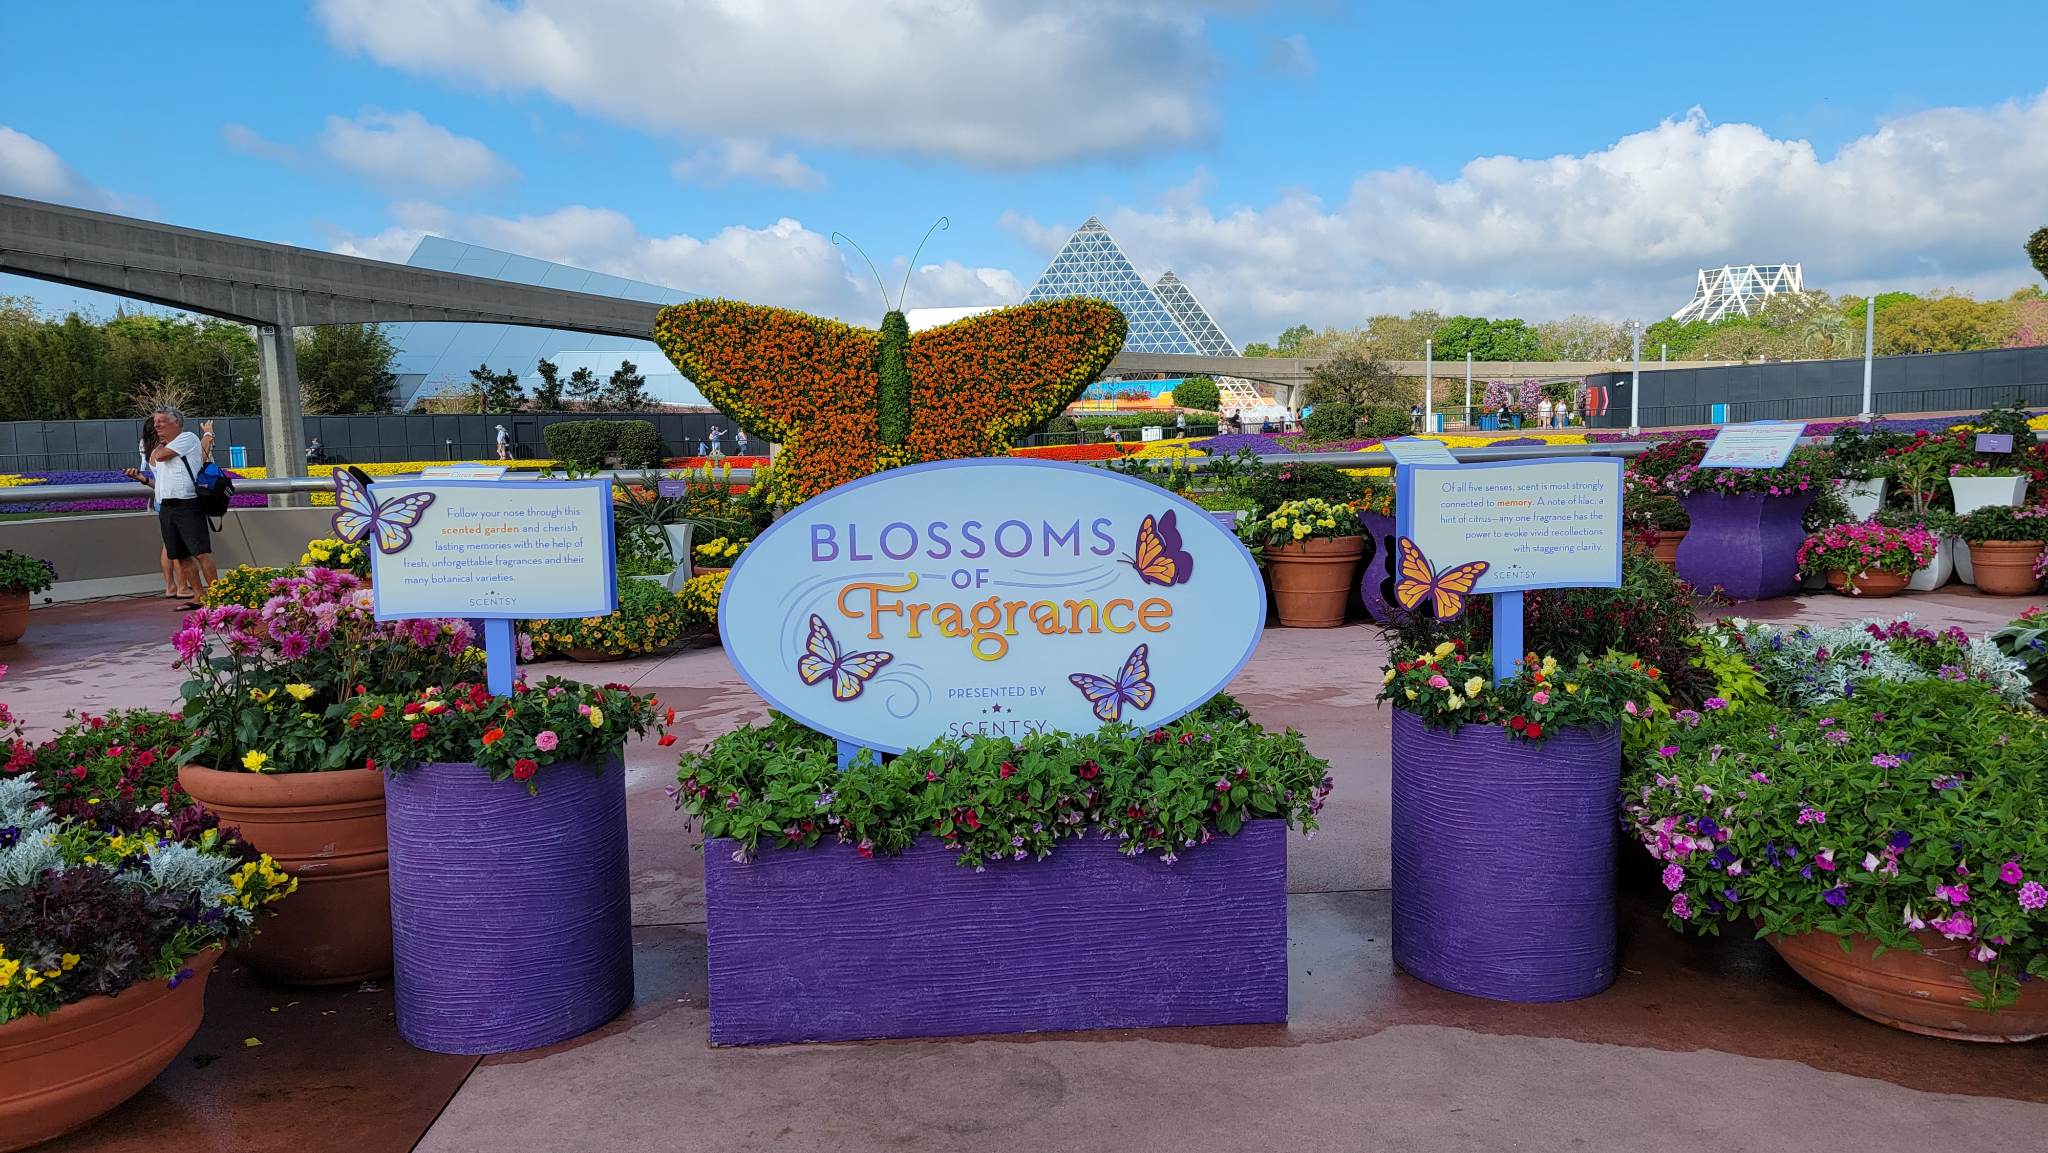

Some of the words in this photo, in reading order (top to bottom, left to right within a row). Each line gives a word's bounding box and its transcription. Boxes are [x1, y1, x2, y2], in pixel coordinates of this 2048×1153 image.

[1441, 482, 1455, 493] Of
[1457, 481, 1467, 492] all
[1468, 482, 1483, 492] five
[1517, 483, 1539, 491] scent
[1541, 482, 1548, 490] is
[1550, 482, 1569, 490] most
[1572, 480, 1604, 491] strongly
[1440, 497, 1484, 508] connected
[1486, 499, 1495, 507] to
[1497, 499, 1535, 509] memory.
[1537, 496, 1545, 506] A
[1547, 498, 1566, 506] note
[1567, 495, 1577, 505] of
[447, 507, 478, 519] Follow
[480, 510, 500, 519] your
[527, 506, 562, 519] through
[564, 505, 581, 516] this
[1440, 513, 1457, 524] hint
[1458, 513, 1467, 523] of
[1533, 511, 1572, 523] fragrance
[1574, 511, 1588, 520] has
[1590, 509, 1604, 520] the
[442, 524, 481, 535] scented
[484, 523, 519, 536] garden
[522, 523, 540, 533] and
[543, 521, 578, 532] cherish
[1465, 532, 1491, 542] power
[1493, 529, 1501, 538] to
[1504, 528, 1528, 537] evoke
[1531, 527, 1549, 537] vivid
[1551, 526, 1604, 537] recollections
[435, 541, 464, 552] lasting
[467, 541, 512, 551] memories
[514, 539, 533, 549] with
[535, 538, 550, 548] the
[552, 537, 572, 550] help
[575, 537, 584, 548] of
[810, 518, 1115, 562] BLOSSOMS
[1513, 542, 1531, 553] with
[1533, 543, 1575, 555] staggering
[1577, 541, 1603, 552] clarity.
[403, 557, 429, 568] fresh,
[432, 555, 493, 569] unforgettable
[495, 554, 542, 568] fragrances
[544, 554, 561, 565] and
[564, 553, 584, 564] their
[404, 576, 428, 586] many
[431, 572, 473, 584] botanical
[476, 573, 516, 582] varieties.
[951, 568, 989, 589] OF
[1493, 571, 1537, 580] SCENTSY
[469, 598, 517, 607] SCENTSY
[837, 571, 1172, 661] Fragrance
[948, 686, 1026, 699] PRESENTED
[1030, 686, 1047, 697] BY
[949, 719, 1048, 738] SCENTSY
